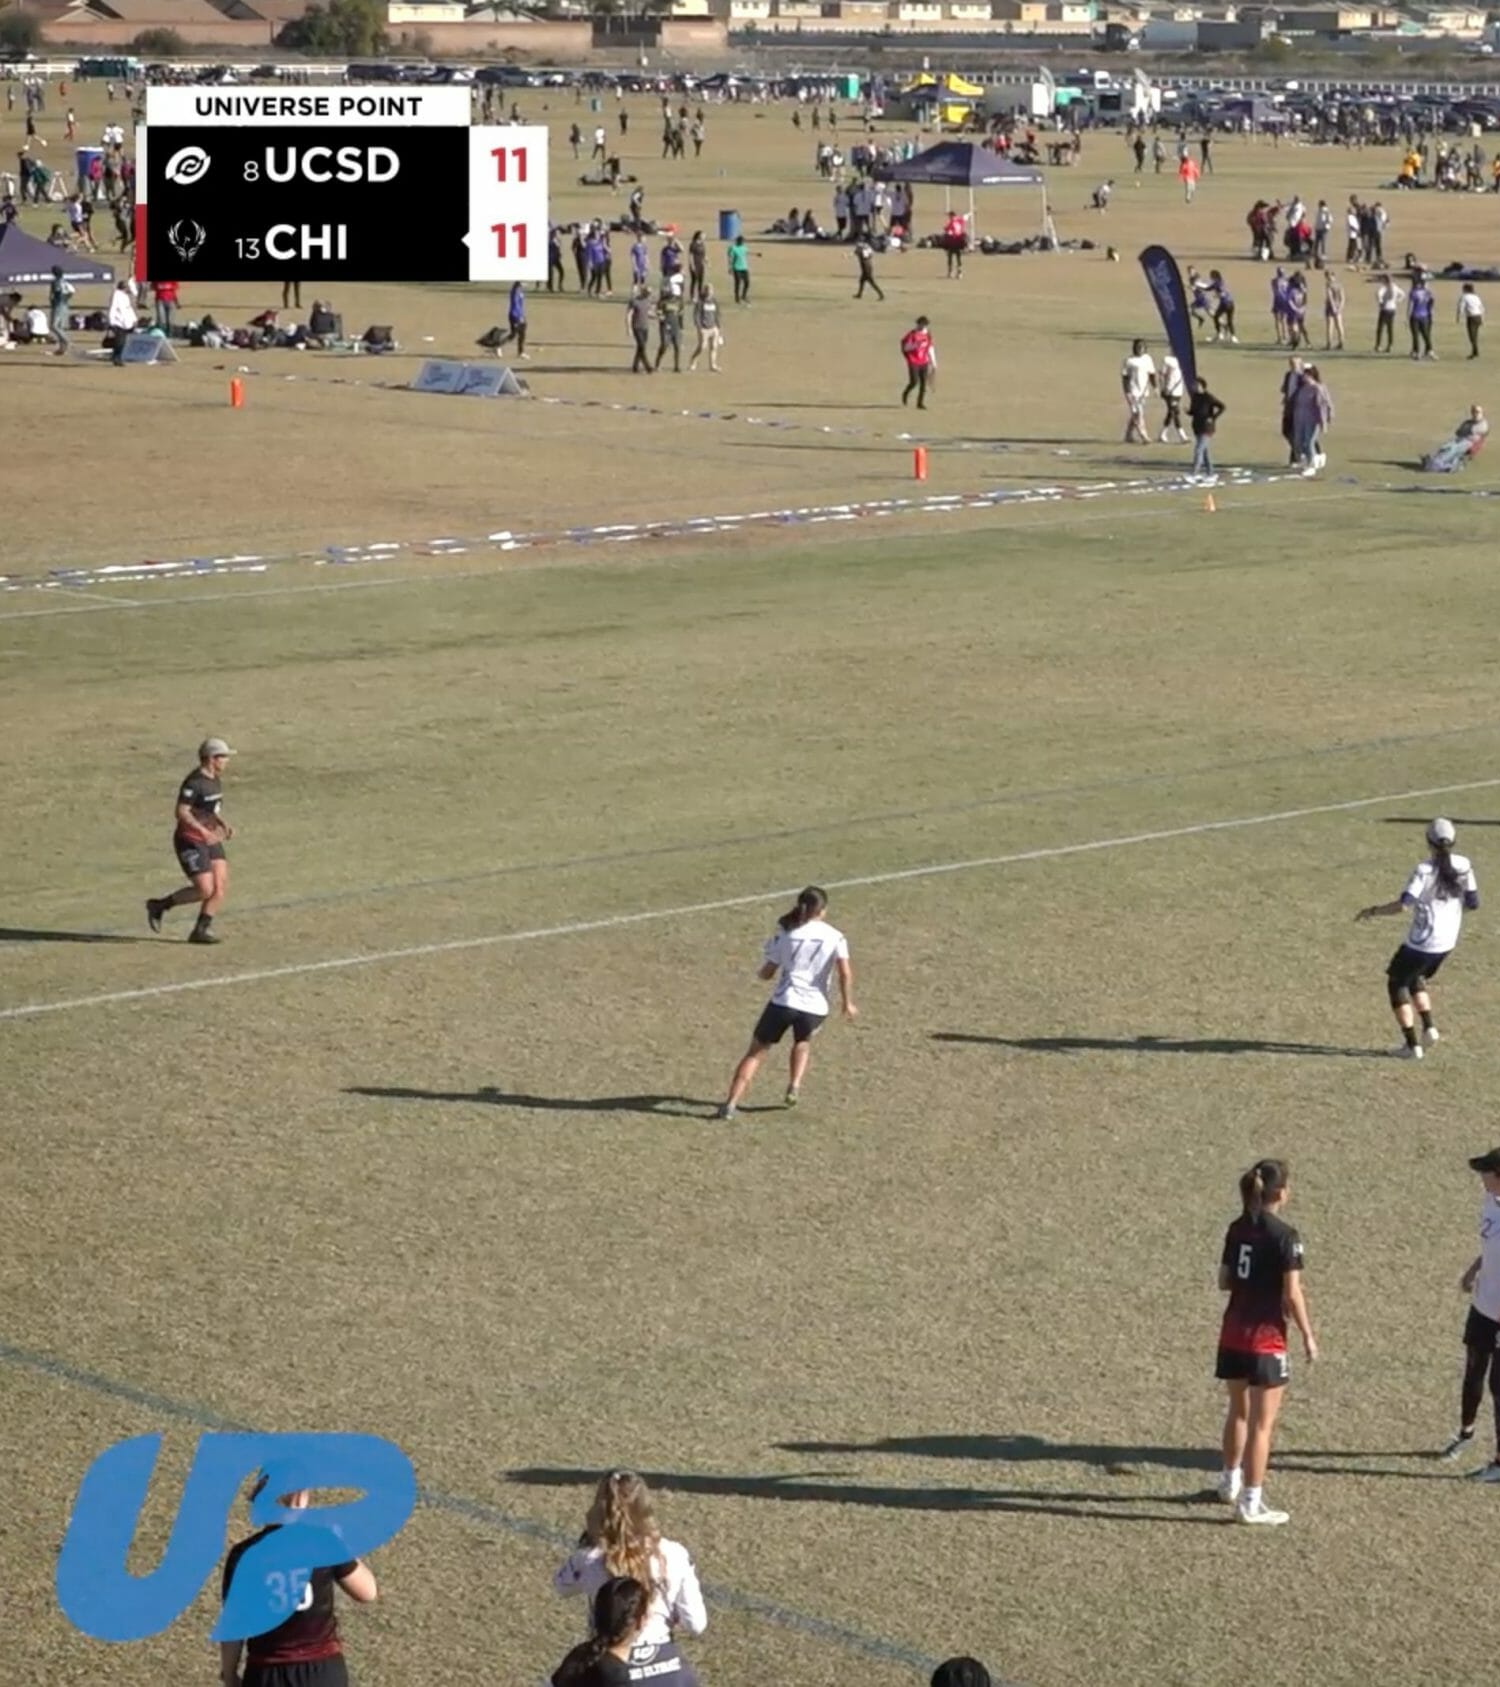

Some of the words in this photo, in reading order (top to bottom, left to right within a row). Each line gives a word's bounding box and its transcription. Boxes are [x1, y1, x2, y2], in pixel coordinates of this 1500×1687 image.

[789, 938, 824, 962] 77
[1237, 1243, 1253, 1279] 5
[265, 1567, 314, 1612] 35
